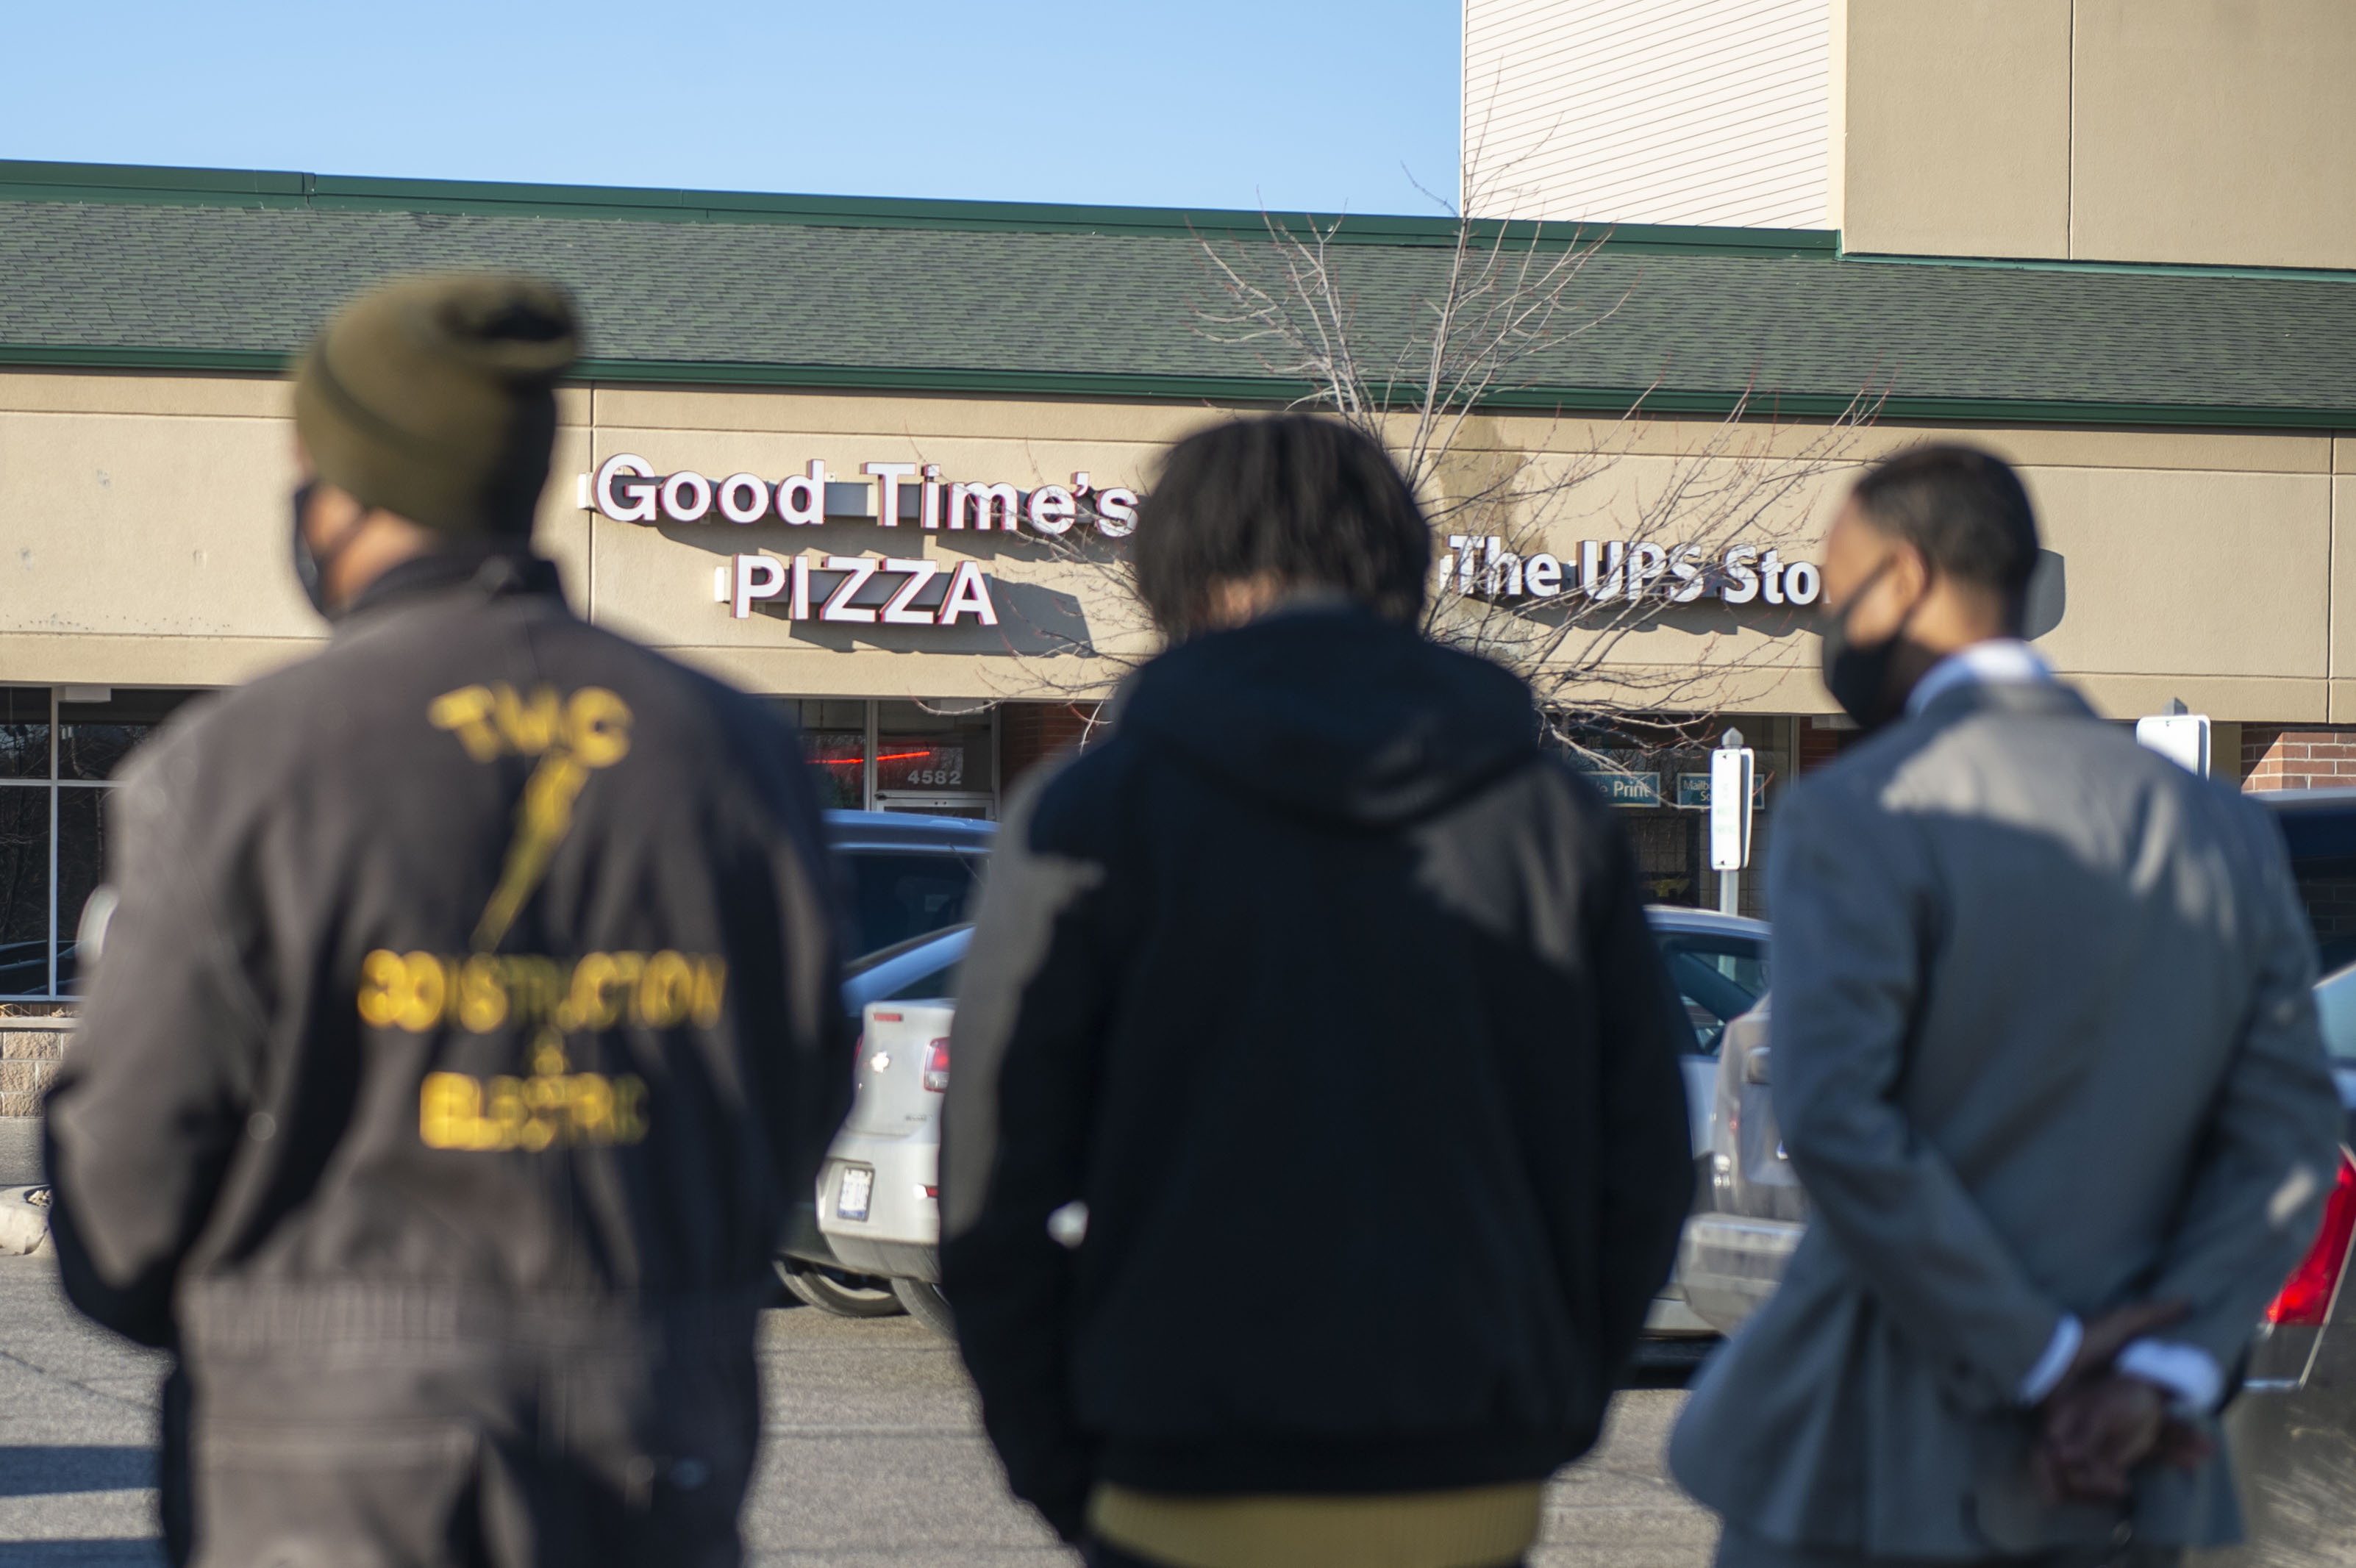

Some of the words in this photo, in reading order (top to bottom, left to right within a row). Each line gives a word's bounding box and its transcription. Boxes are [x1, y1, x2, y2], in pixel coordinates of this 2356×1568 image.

[593, 452, 826, 526] Good
[860, 461, 1139, 538] Time's
[731, 553, 999, 626] PIZZA
[1448, 534, 1563, 597] The
[1576, 540, 1705, 603] UPS
[1721, 543, 1831, 606] Sto
[907, 770, 962, 785] 4582
[1613, 780, 1650, 798] Print
